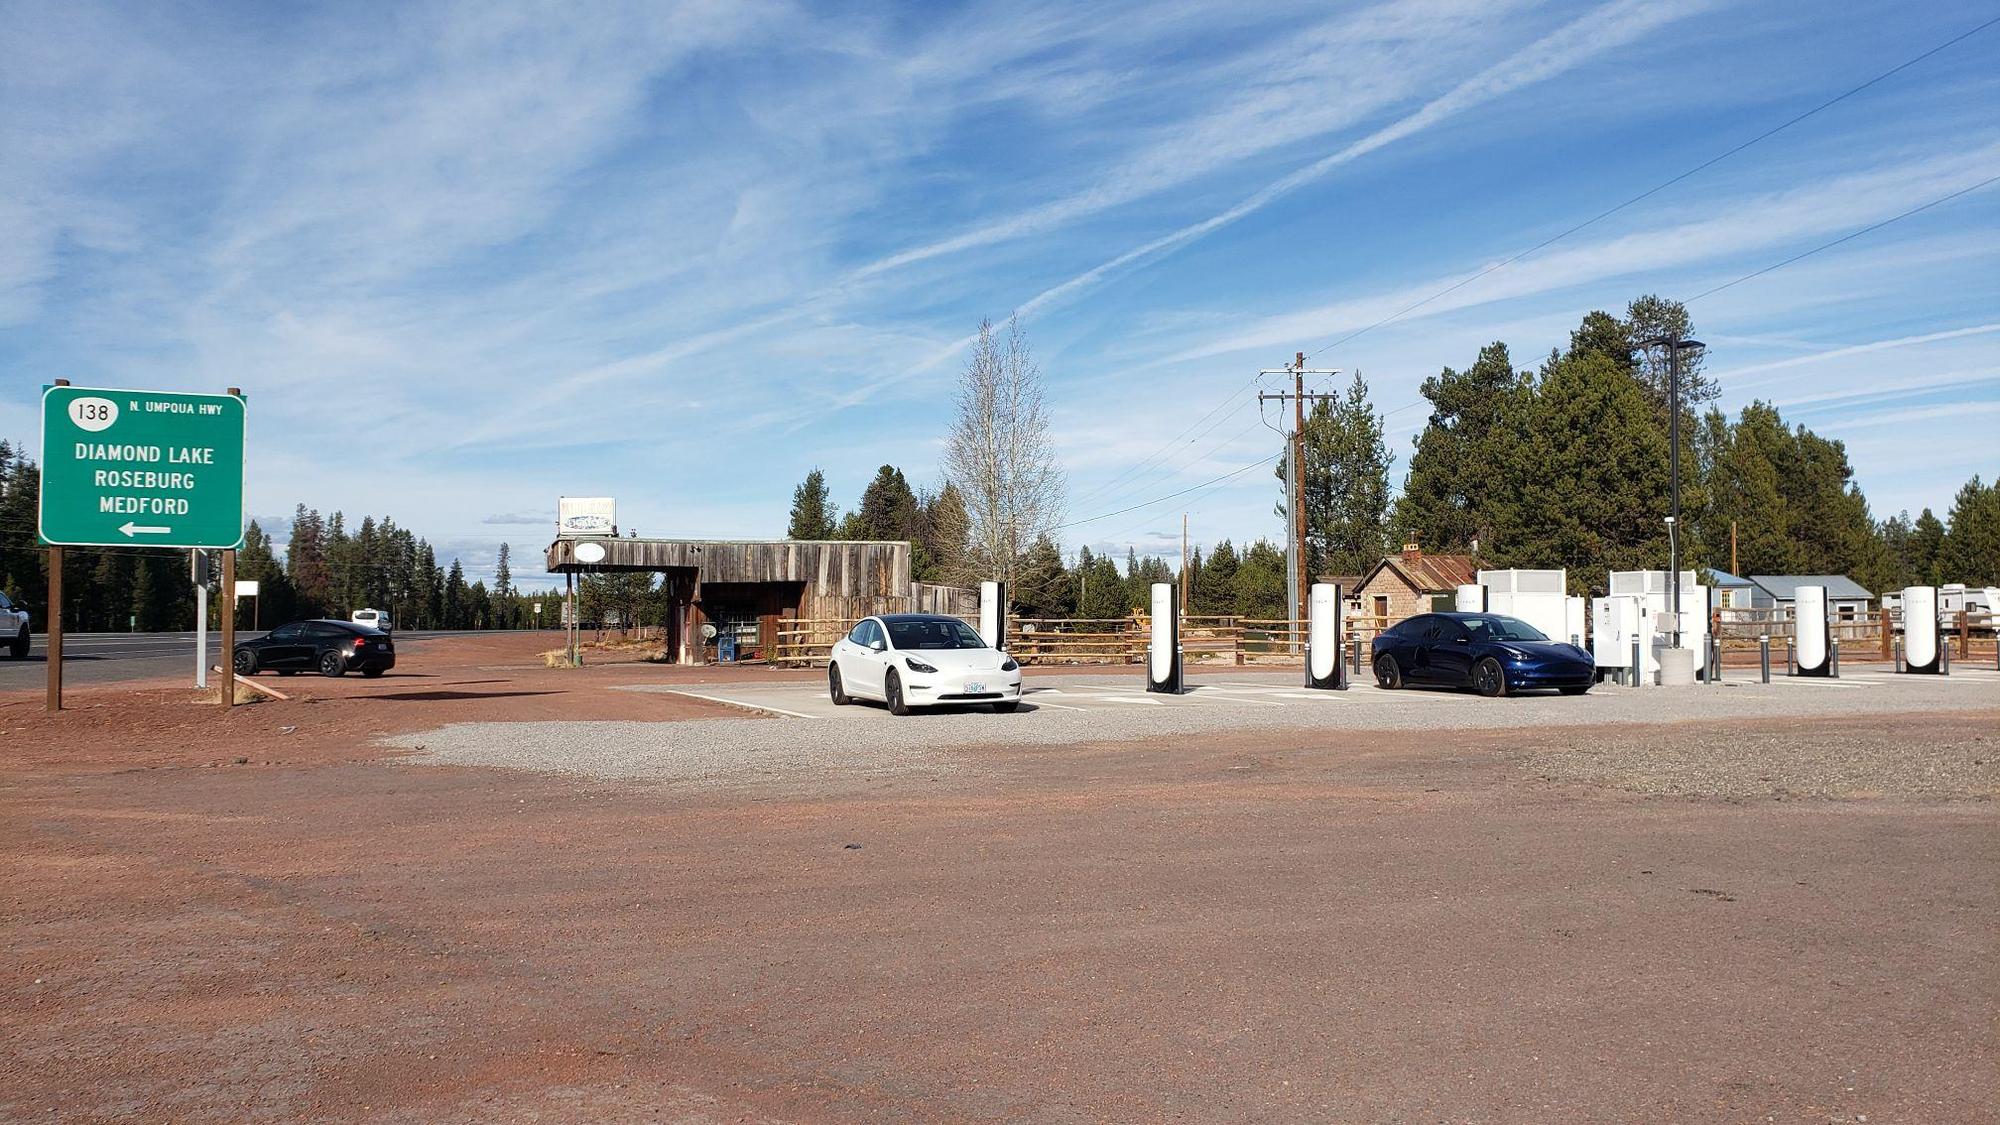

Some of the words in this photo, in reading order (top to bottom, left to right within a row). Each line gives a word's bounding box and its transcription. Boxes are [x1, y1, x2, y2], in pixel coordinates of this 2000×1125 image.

[78, 403, 109, 421] 138
[130, 401, 140, 412] N.
[145, 402, 195, 415] UMPQUA
[199, 404, 223, 415] HWY
[75, 443, 161, 462] DIAMOND
[169, 447, 214, 464] LAKE
[95, 470, 195, 489] ROSEBURG
[100, 496, 189, 515] MEDFORD
